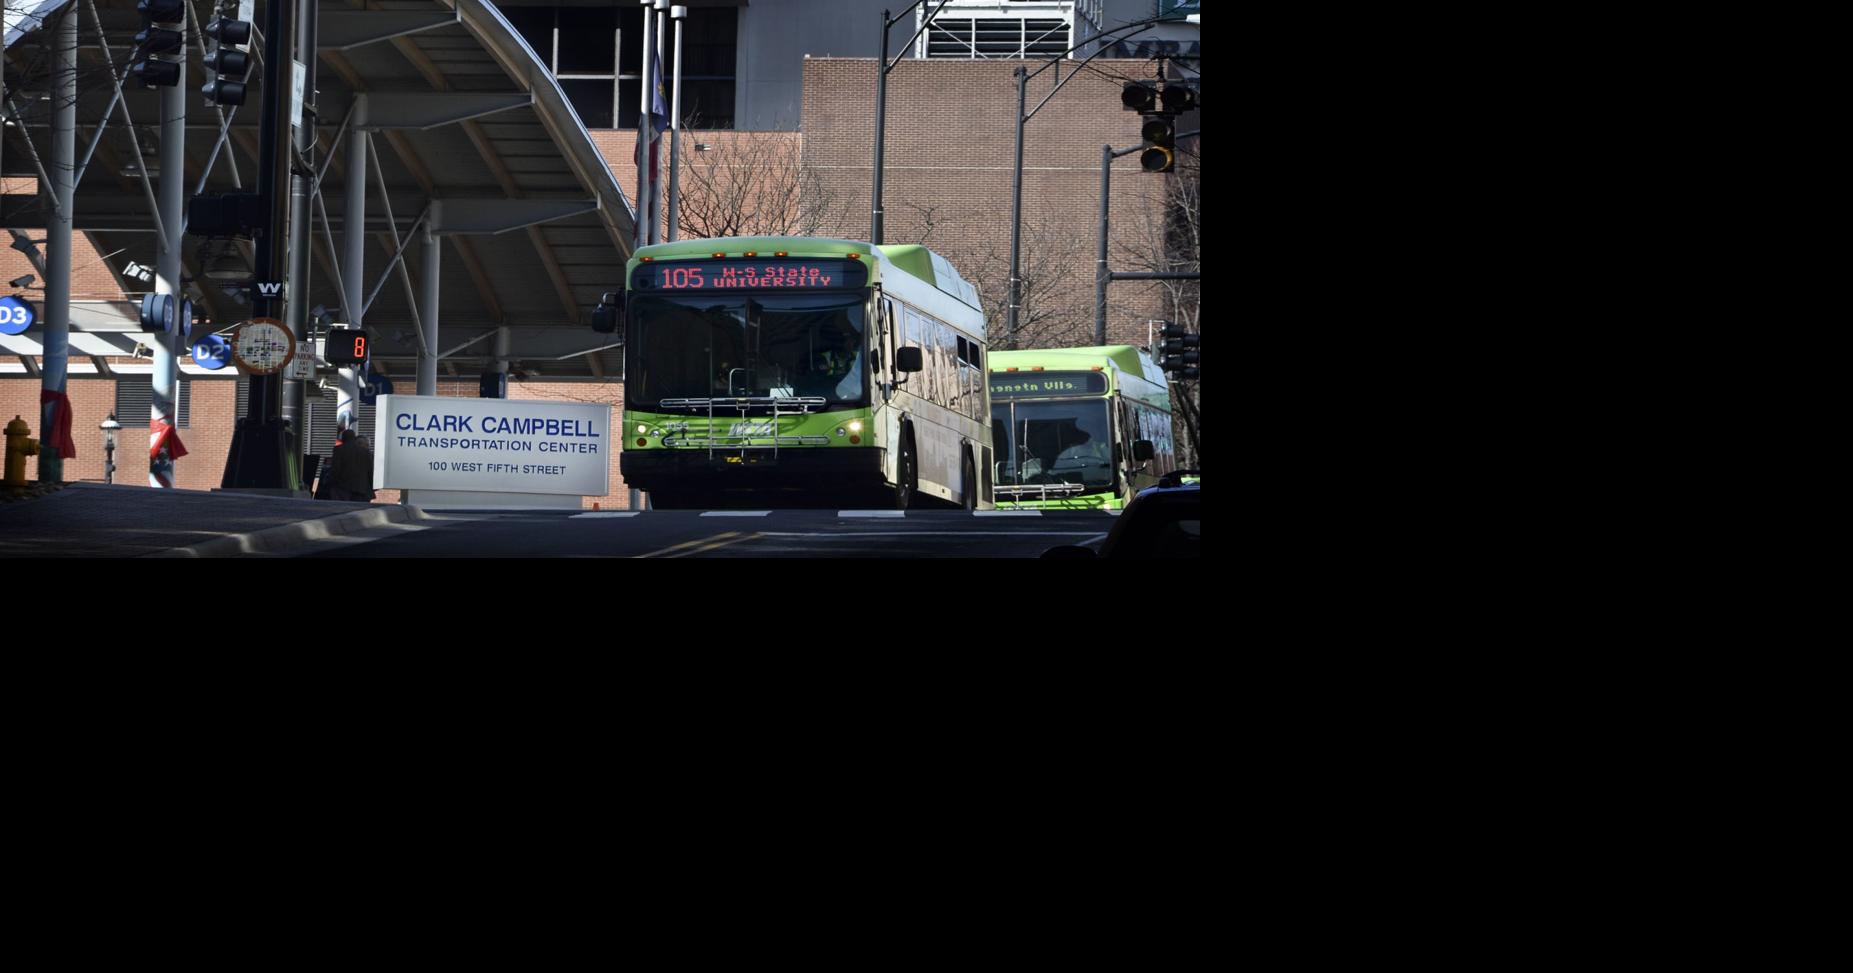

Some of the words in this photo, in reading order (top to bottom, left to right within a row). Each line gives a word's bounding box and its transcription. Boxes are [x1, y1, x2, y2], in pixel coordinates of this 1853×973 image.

[662, 268, 704, 289] 105
[723, 267, 756, 278] W-S
[765, 266, 820, 277] State
[713, 276, 831, 288] UNIVERSITY
[0, 306, 27, 325] D3
[196, 344, 225, 361] D2
[354, 336, 365, 358] 8
[396, 413, 473, 433] CLARK
[481, 416, 600, 438] CAMPBELL
[398, 436, 532, 452] TRANSPORTATION
[538, 441, 598, 454] CENTER
[428, 461, 447, 471] 100
[451, 462, 483, 472] WEST
[487, 463, 519, 474] FIFTH
[523, 464, 567, 475] STREET
